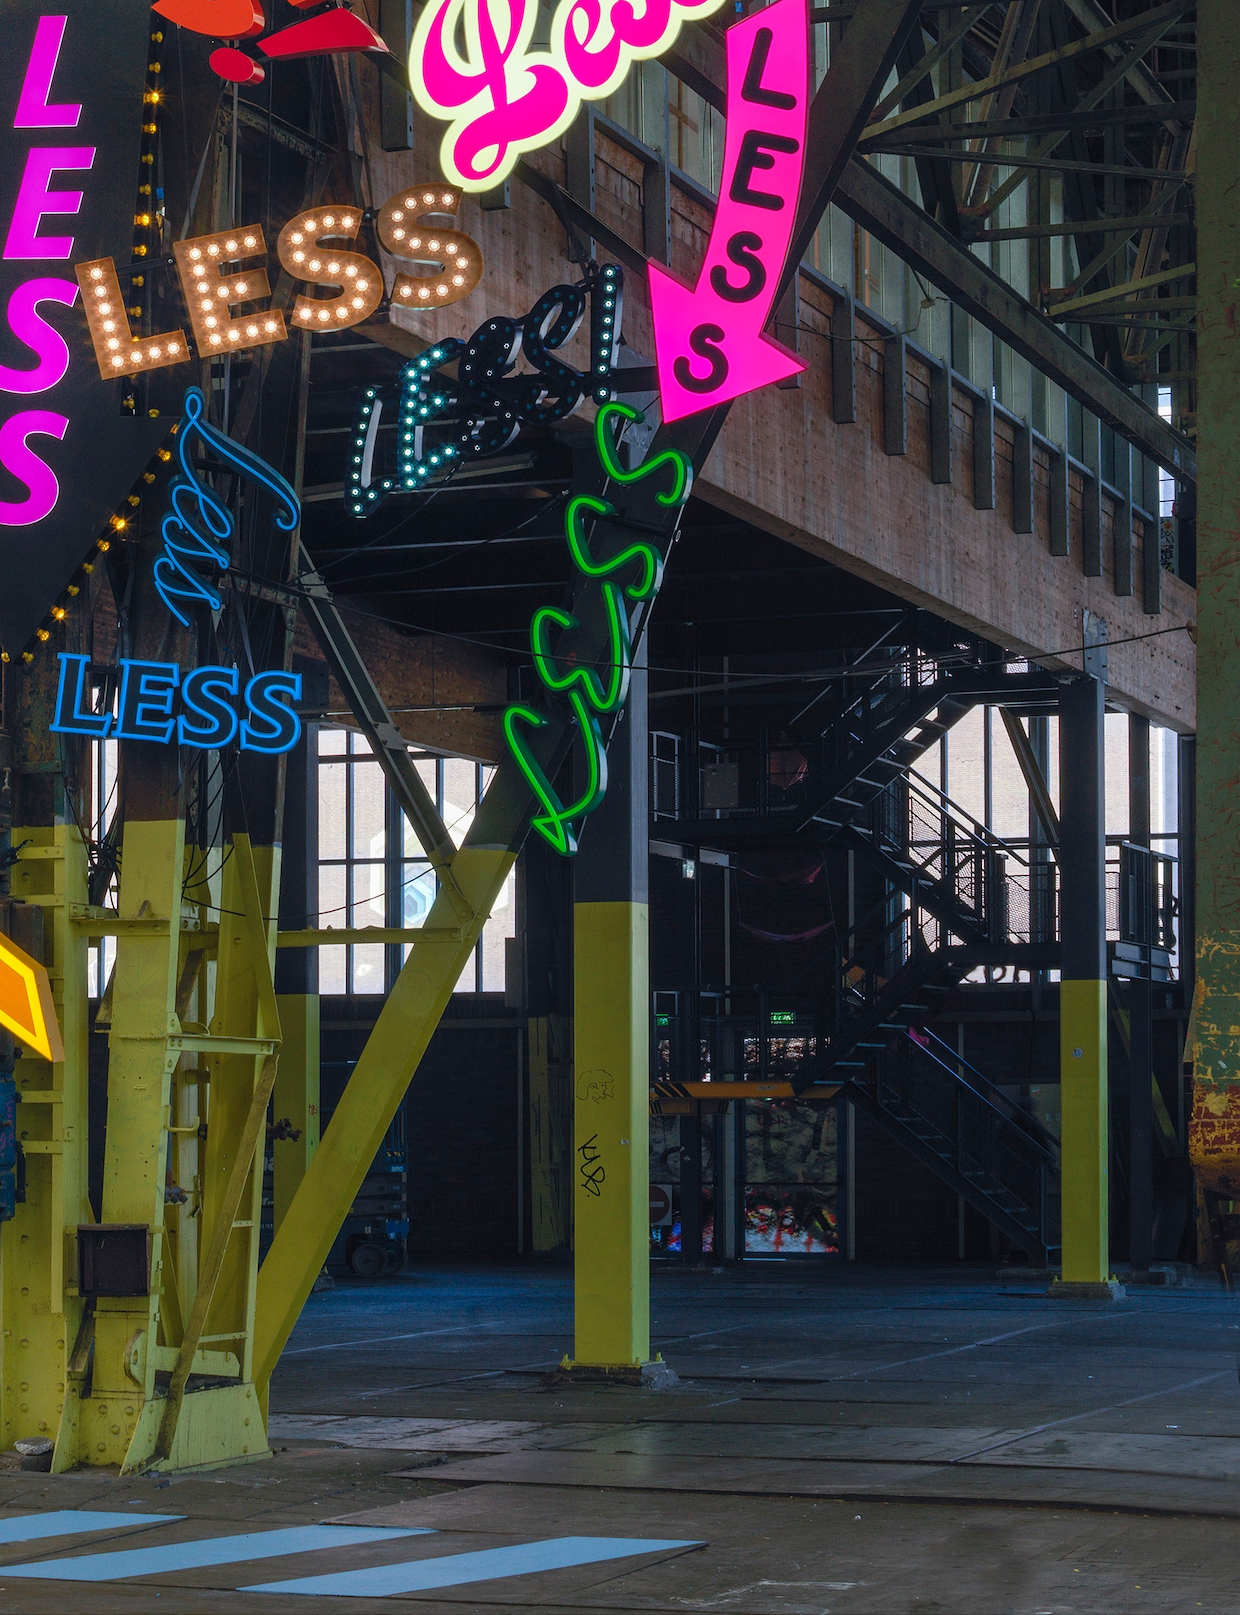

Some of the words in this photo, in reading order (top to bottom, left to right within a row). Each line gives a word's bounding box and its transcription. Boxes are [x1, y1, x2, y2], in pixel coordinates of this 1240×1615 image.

[74, 184, 485, 381] LESS
[672, 26, 800, 395] LESS
[48, 651, 303, 756] LESS
